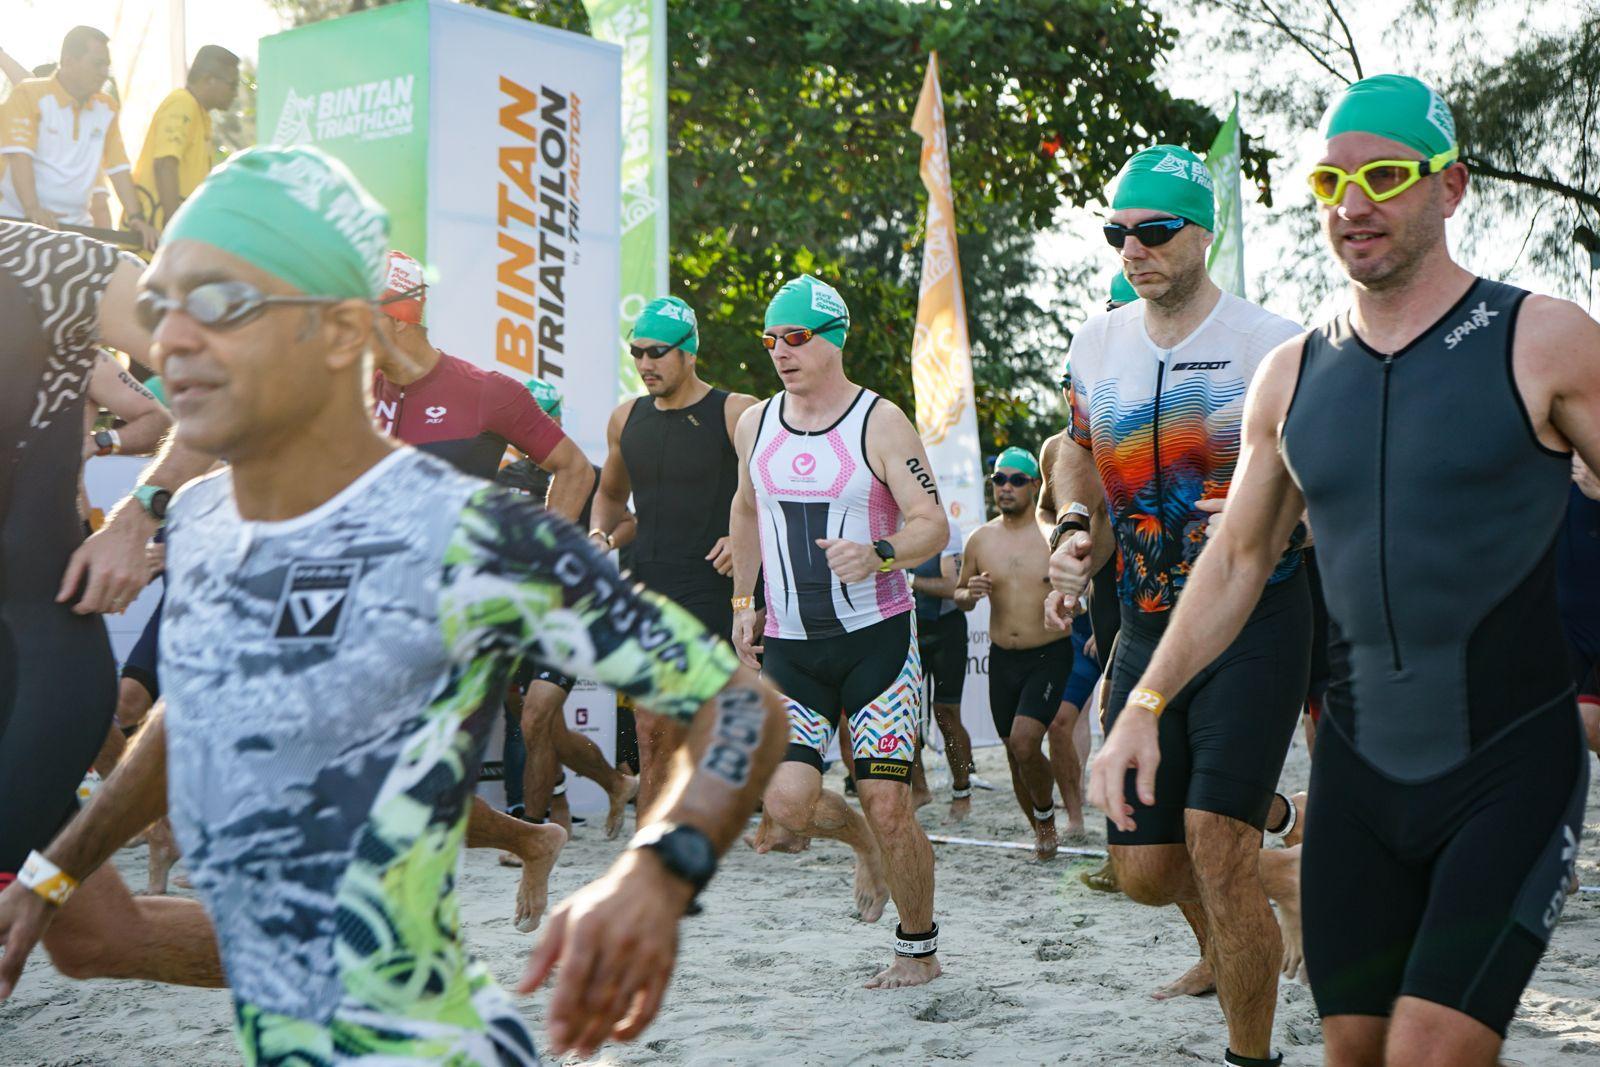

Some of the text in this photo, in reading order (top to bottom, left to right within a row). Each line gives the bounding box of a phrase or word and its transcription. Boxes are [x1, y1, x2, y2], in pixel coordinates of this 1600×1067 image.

[318, 74, 414, 120] BINTAN
[316, 104, 414, 141] TRIATHLON
[568, 92, 581, 244] TRIFACTOR
[496, 75, 538, 376] BINTAN
[538, 85, 567, 380] TRIATHLON
[1186, 360, 1232, 371] ZOOT
[880, 737, 896, 750] C4
[872, 764, 907, 775] MAVIC
